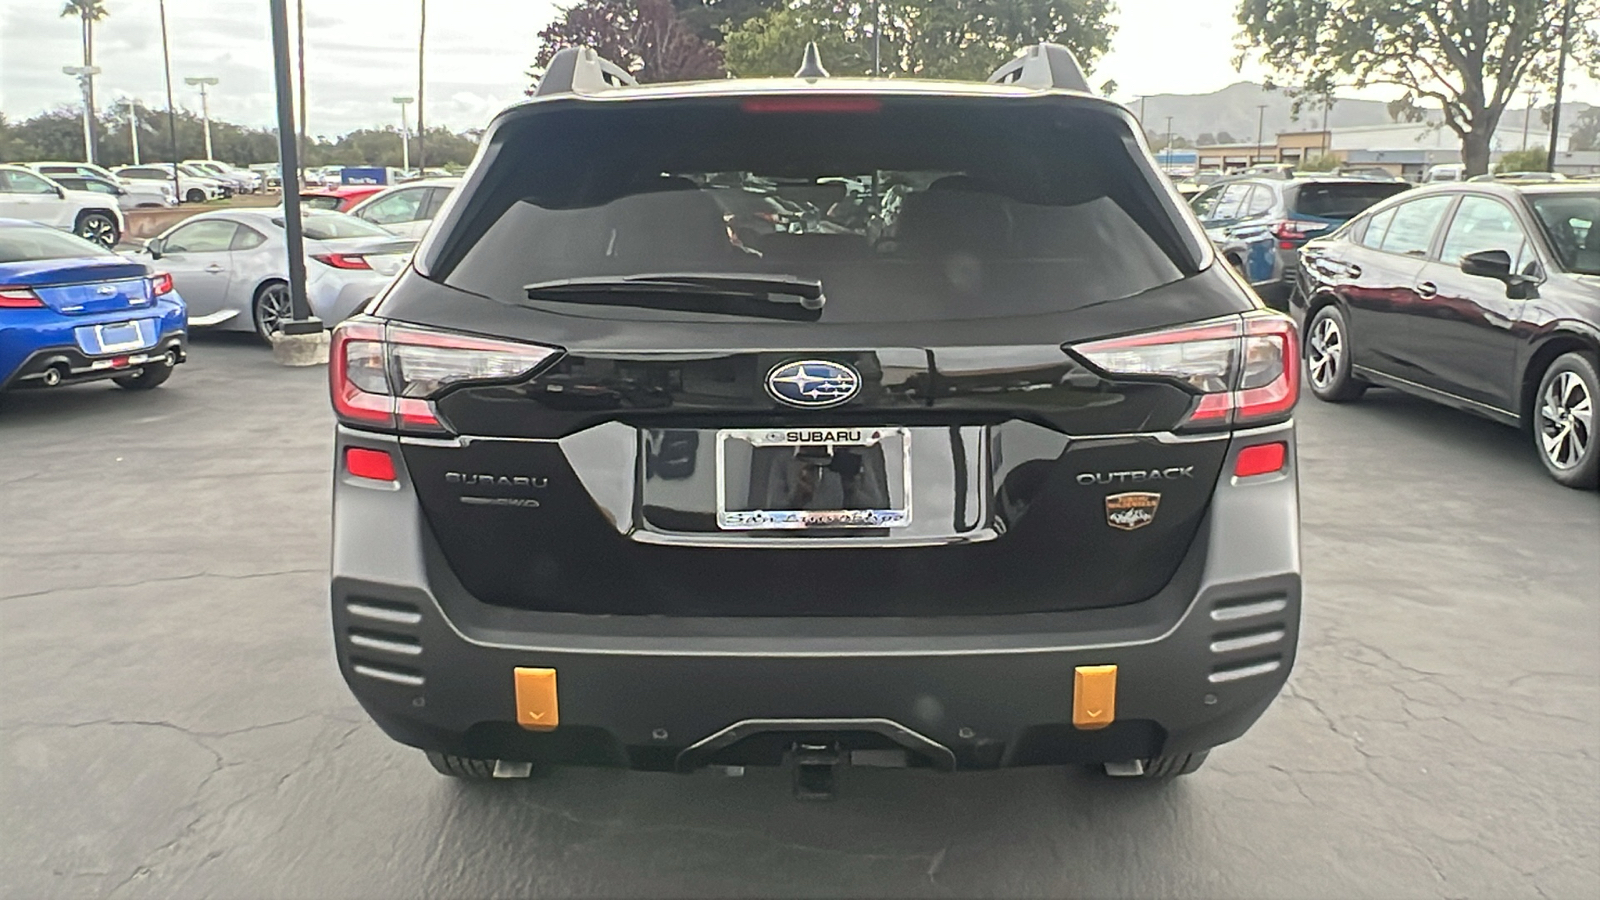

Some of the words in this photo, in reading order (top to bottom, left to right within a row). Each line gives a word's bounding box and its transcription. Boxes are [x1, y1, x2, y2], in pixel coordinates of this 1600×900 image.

[786, 431, 861, 442] SUBARU
[445, 471, 548, 488] SUBARU
[1076, 465, 1194, 486] OUTBACK
